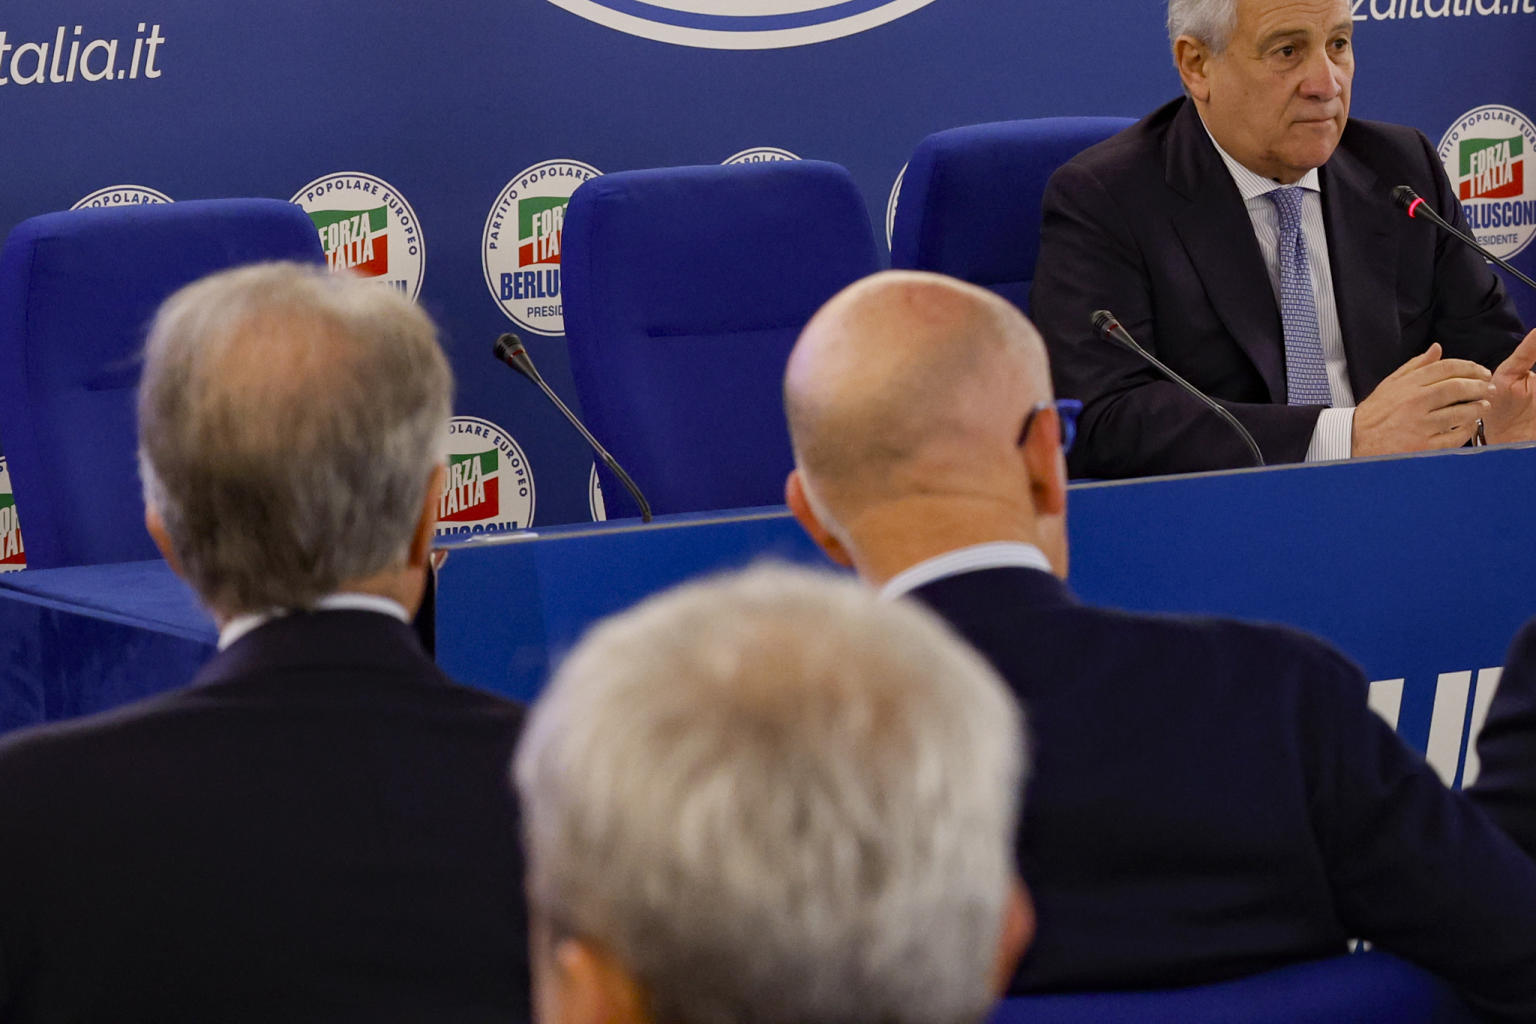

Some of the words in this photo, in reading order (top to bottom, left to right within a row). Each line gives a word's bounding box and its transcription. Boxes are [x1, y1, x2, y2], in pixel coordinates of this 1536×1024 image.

[0, 23, 165, 86] talia.it
[1462, 112, 1516, 131] POPOLARE
[1470, 141, 1511, 174] FORZA
[1470, 162, 1514, 198] ITALIA
[86, 193, 158, 208] OPOLARE
[307, 179, 379, 202] POPOLARE
[382, 192, 418, 256] EUROPEO
[490, 189, 517, 249] PARTITO
[521, 167, 590, 188] POPOLARE
[532, 202, 567, 236] FOR
[324, 236, 374, 273] TALIA
[500, 269, 560, 301] BERLU
[493, 436, 528, 497] EUROPEO
[440, 478, 486, 518] TALIA
